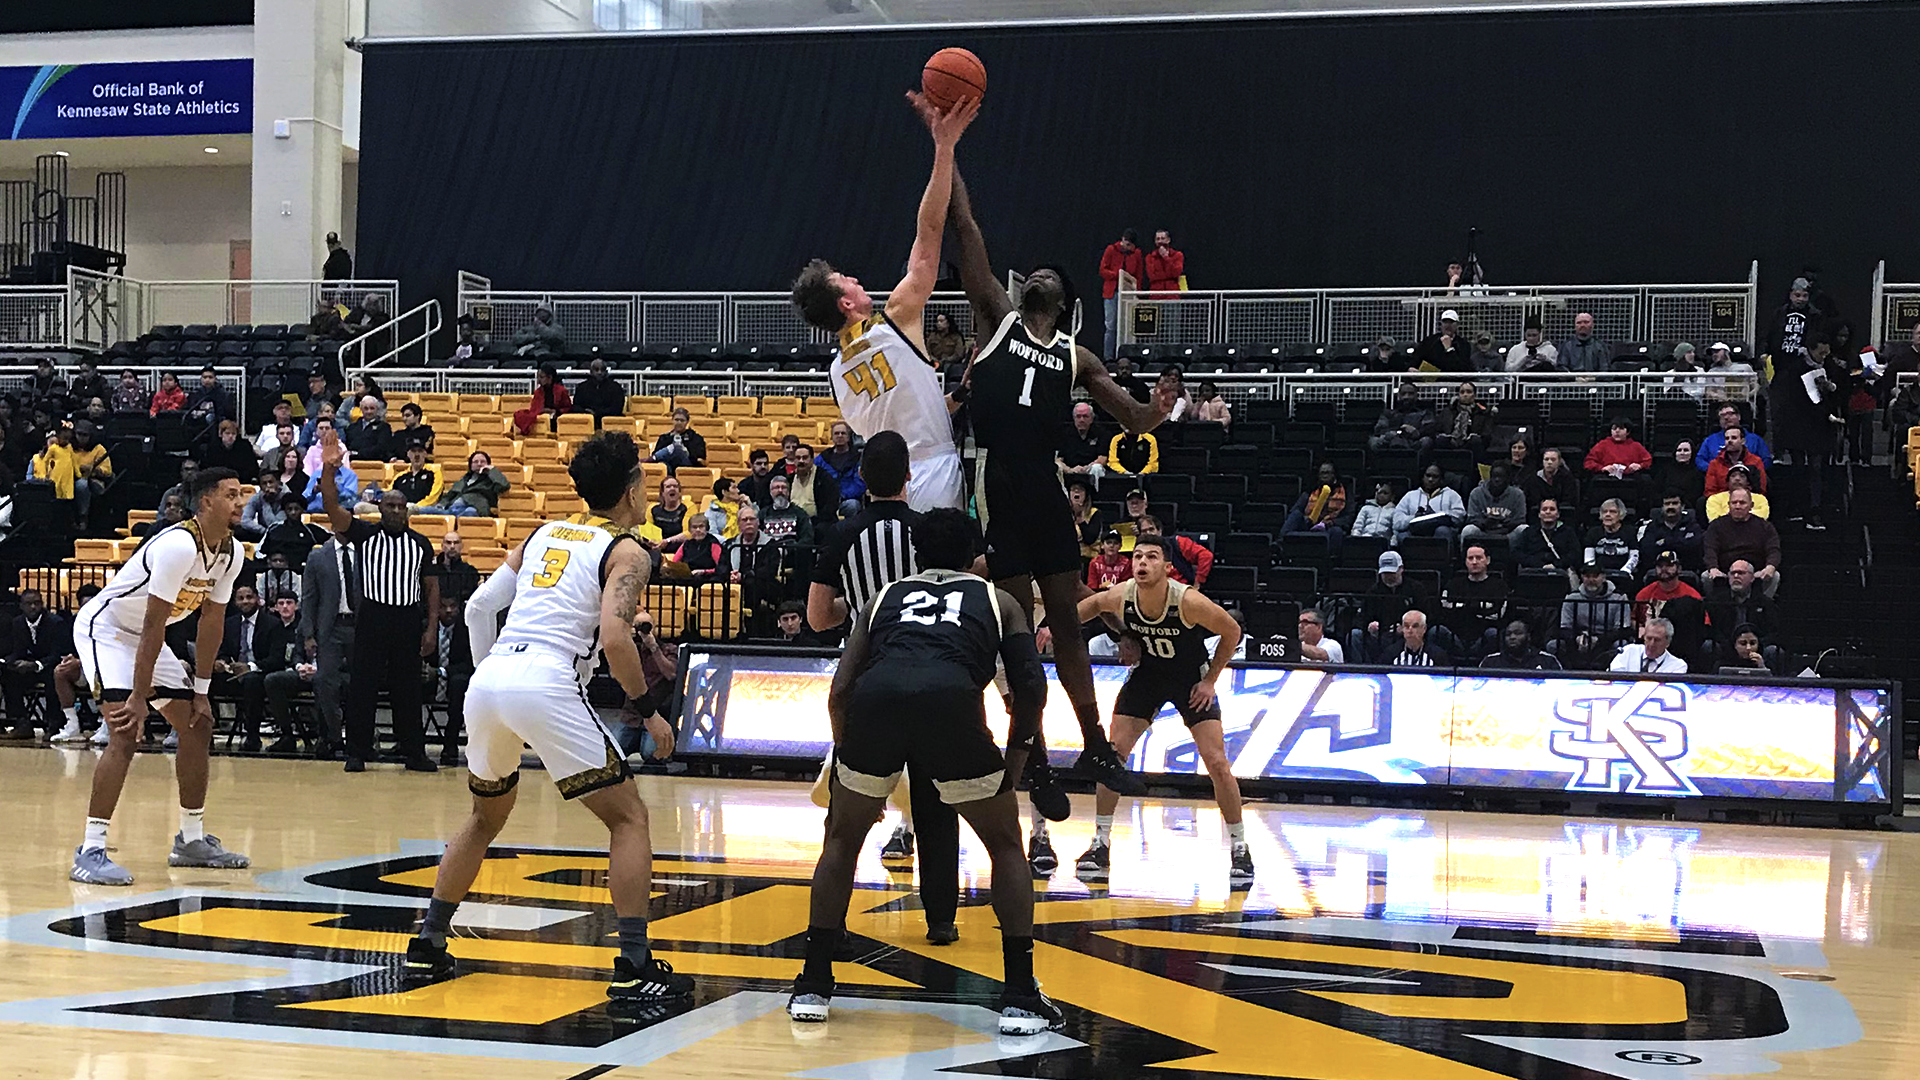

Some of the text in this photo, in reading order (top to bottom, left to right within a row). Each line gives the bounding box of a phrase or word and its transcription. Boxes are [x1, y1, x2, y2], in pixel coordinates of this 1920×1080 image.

[92, 81, 204, 98] Official Bank of
[57, 100, 240, 118] Kennesaw State Athletics
[1138, 313, 1153, 322] 104
[1716, 308, 1732, 317] 104
[1903, 308, 1919, 317] 103
[1008, 338, 1064, 371] WOFFORD
[841, 349, 897, 403] 41
[1018, 366, 1036, 407] 1
[532, 547, 571, 588] 3
[899, 590, 964, 627] 21
[1129, 622, 1181, 636] WOFFORD
[1142, 636, 1176, 659] 10
[1260, 643, 1285, 657] POSS
